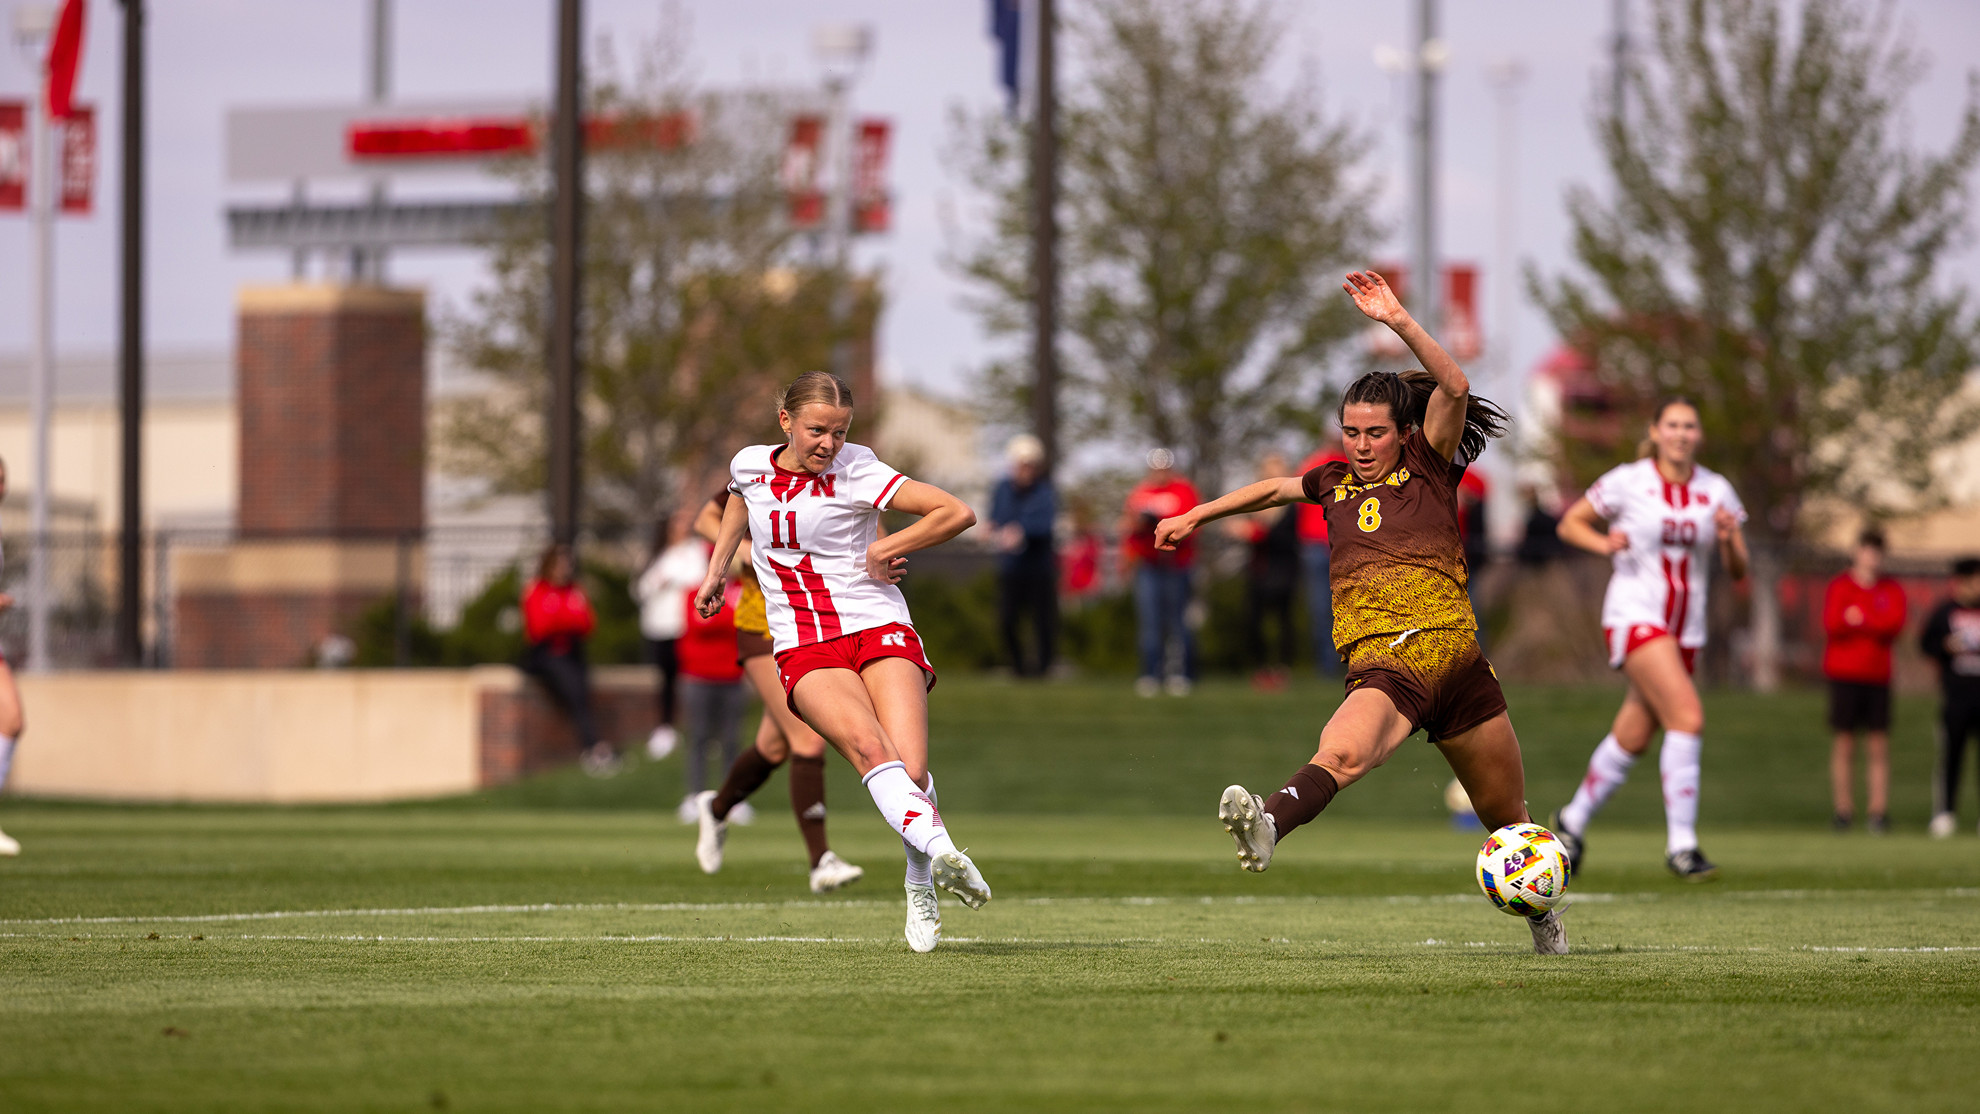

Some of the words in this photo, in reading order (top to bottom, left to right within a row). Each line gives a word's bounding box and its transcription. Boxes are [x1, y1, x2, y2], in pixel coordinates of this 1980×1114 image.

[810, 473, 837, 498] N
[1357, 497, 1383, 533] 8
[768, 510, 801, 550] 11
[1661, 519, 1697, 547] 20
[881, 630, 907, 648] N
